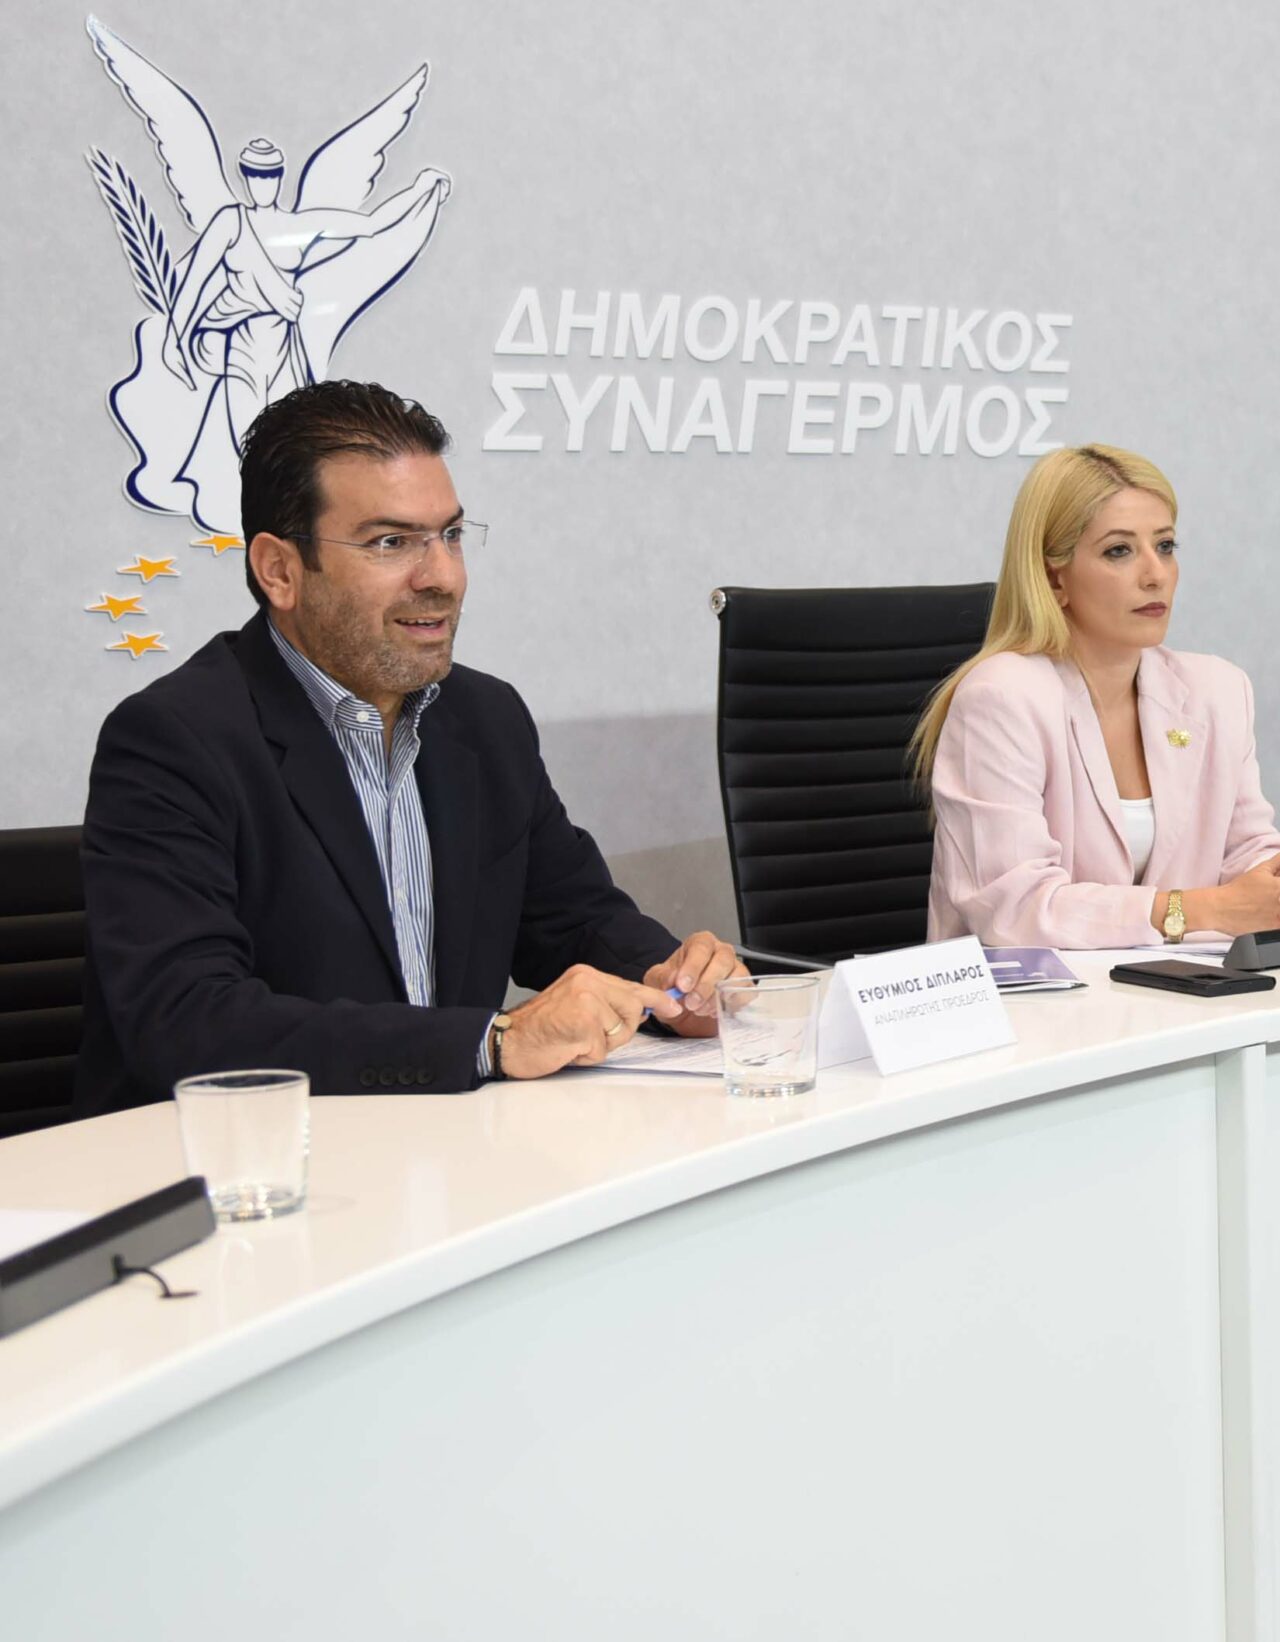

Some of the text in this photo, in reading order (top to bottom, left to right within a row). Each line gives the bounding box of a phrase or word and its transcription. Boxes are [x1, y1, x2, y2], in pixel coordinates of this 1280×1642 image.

[493, 286, 1073, 372] ΔΗΜΟΚΡΑΤΙΚΟΣ
[482, 372, 1069, 458] ΣΥΝΑΓΕΡΜΟΣ
[858, 965, 984, 1003] ΕΥΘΥΜΙΟΣ ΔΙΠΛΑΡΟΣ
[942, 990, 989, 1011] ΠΡΟΕΔΡΟΣ
